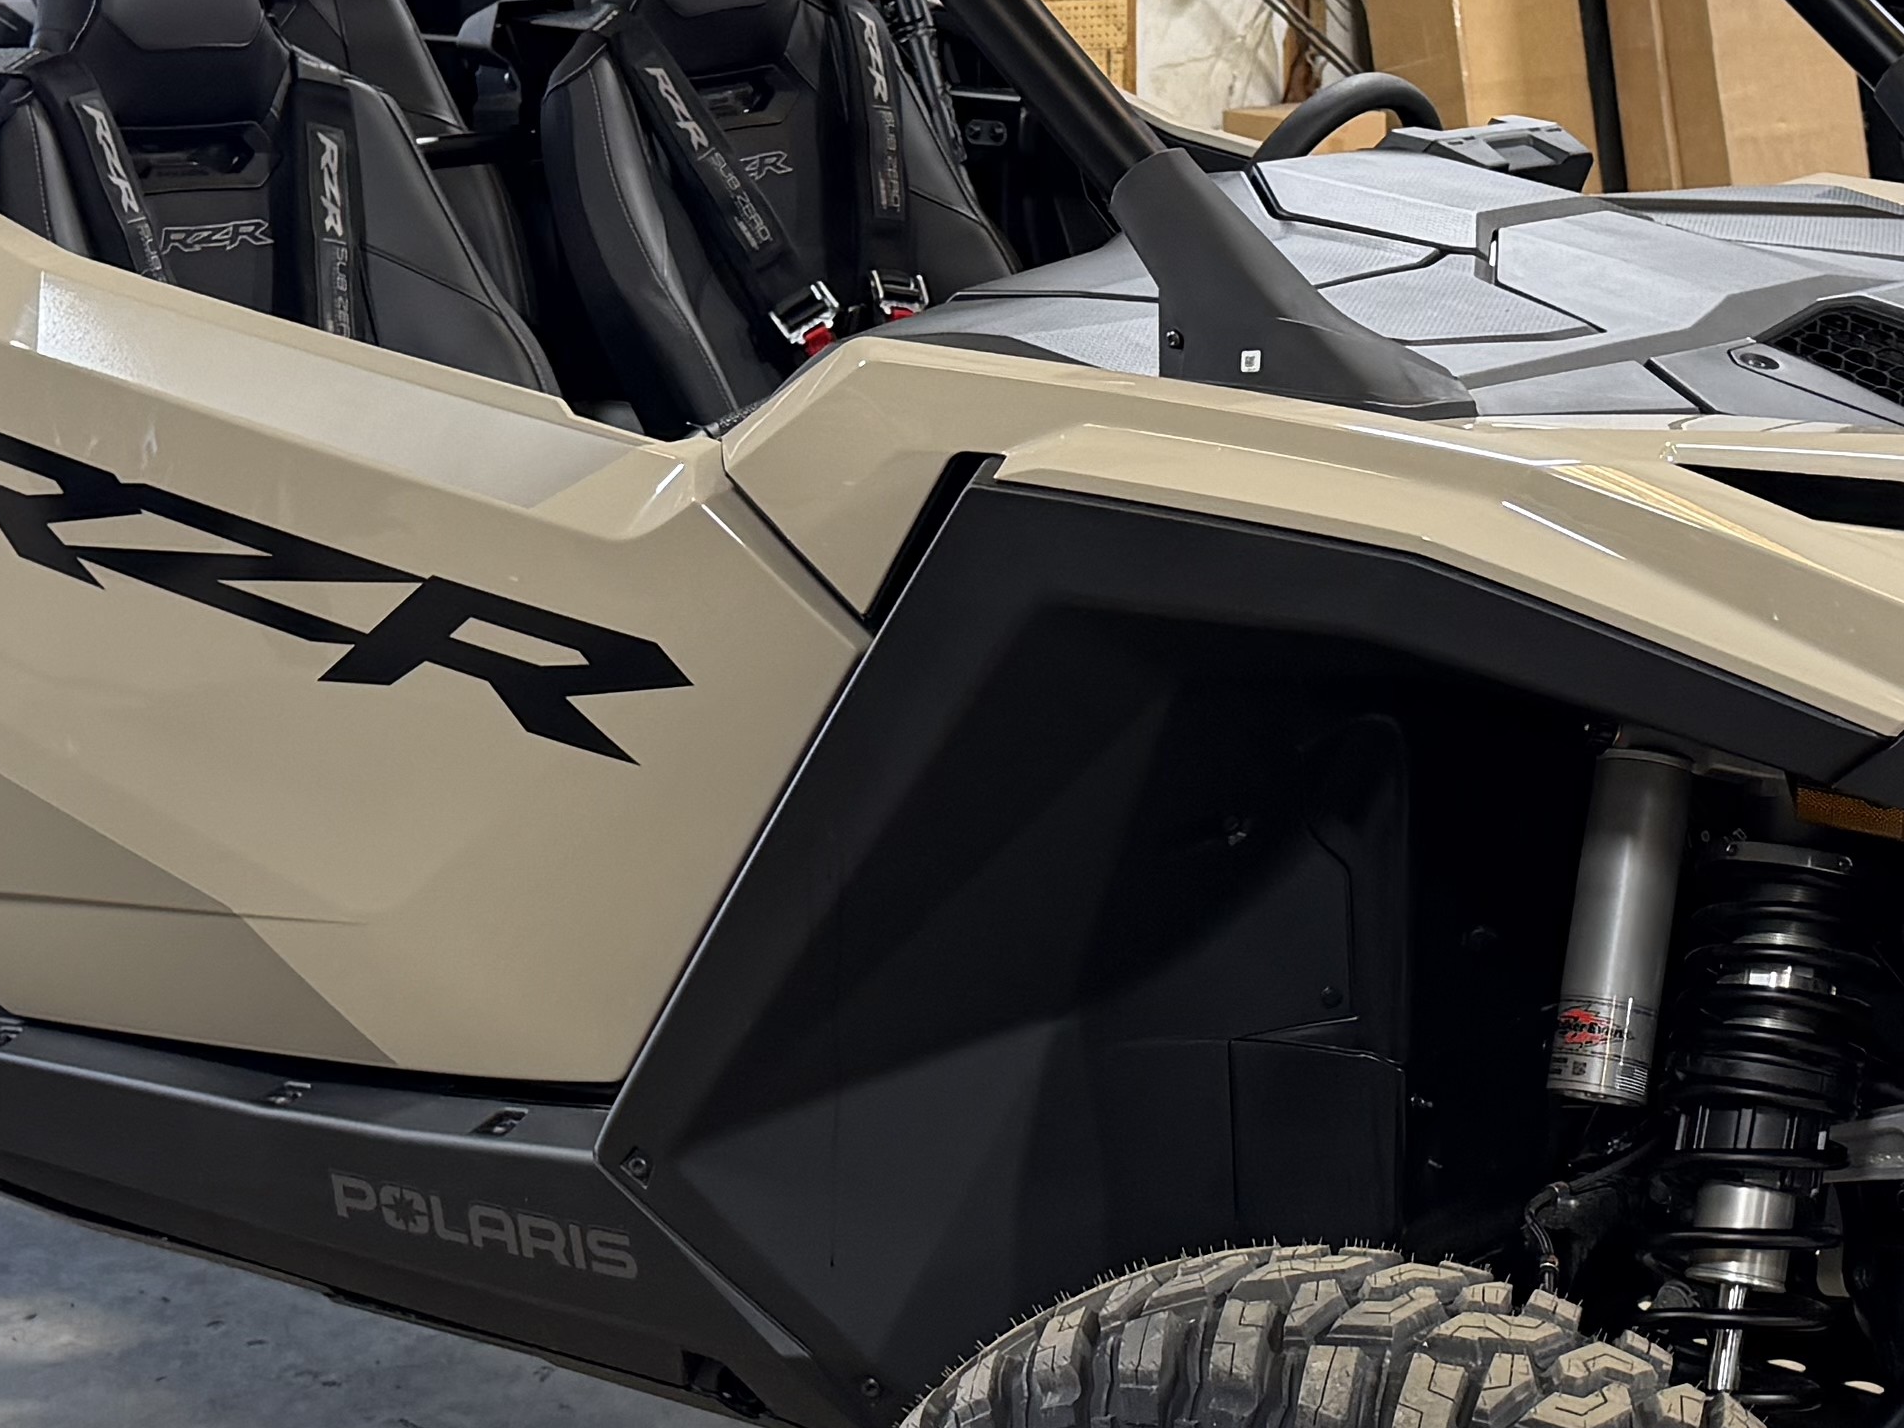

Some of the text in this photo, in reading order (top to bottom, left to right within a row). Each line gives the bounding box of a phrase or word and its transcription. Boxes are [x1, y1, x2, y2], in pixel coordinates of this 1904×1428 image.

[857, 11, 889, 103] RZR
[81, 103, 141, 214] RZR
[644, 67, 710, 152] RZR
[710, 152, 742, 191] SUB
[736, 191, 773, 242] ZERO
[158, 218, 275, 255] RZR
[316, 131, 344, 238] RZR
[335, 246, 349, 292] SUB
[330, 1171, 640, 1281] POLARIS
